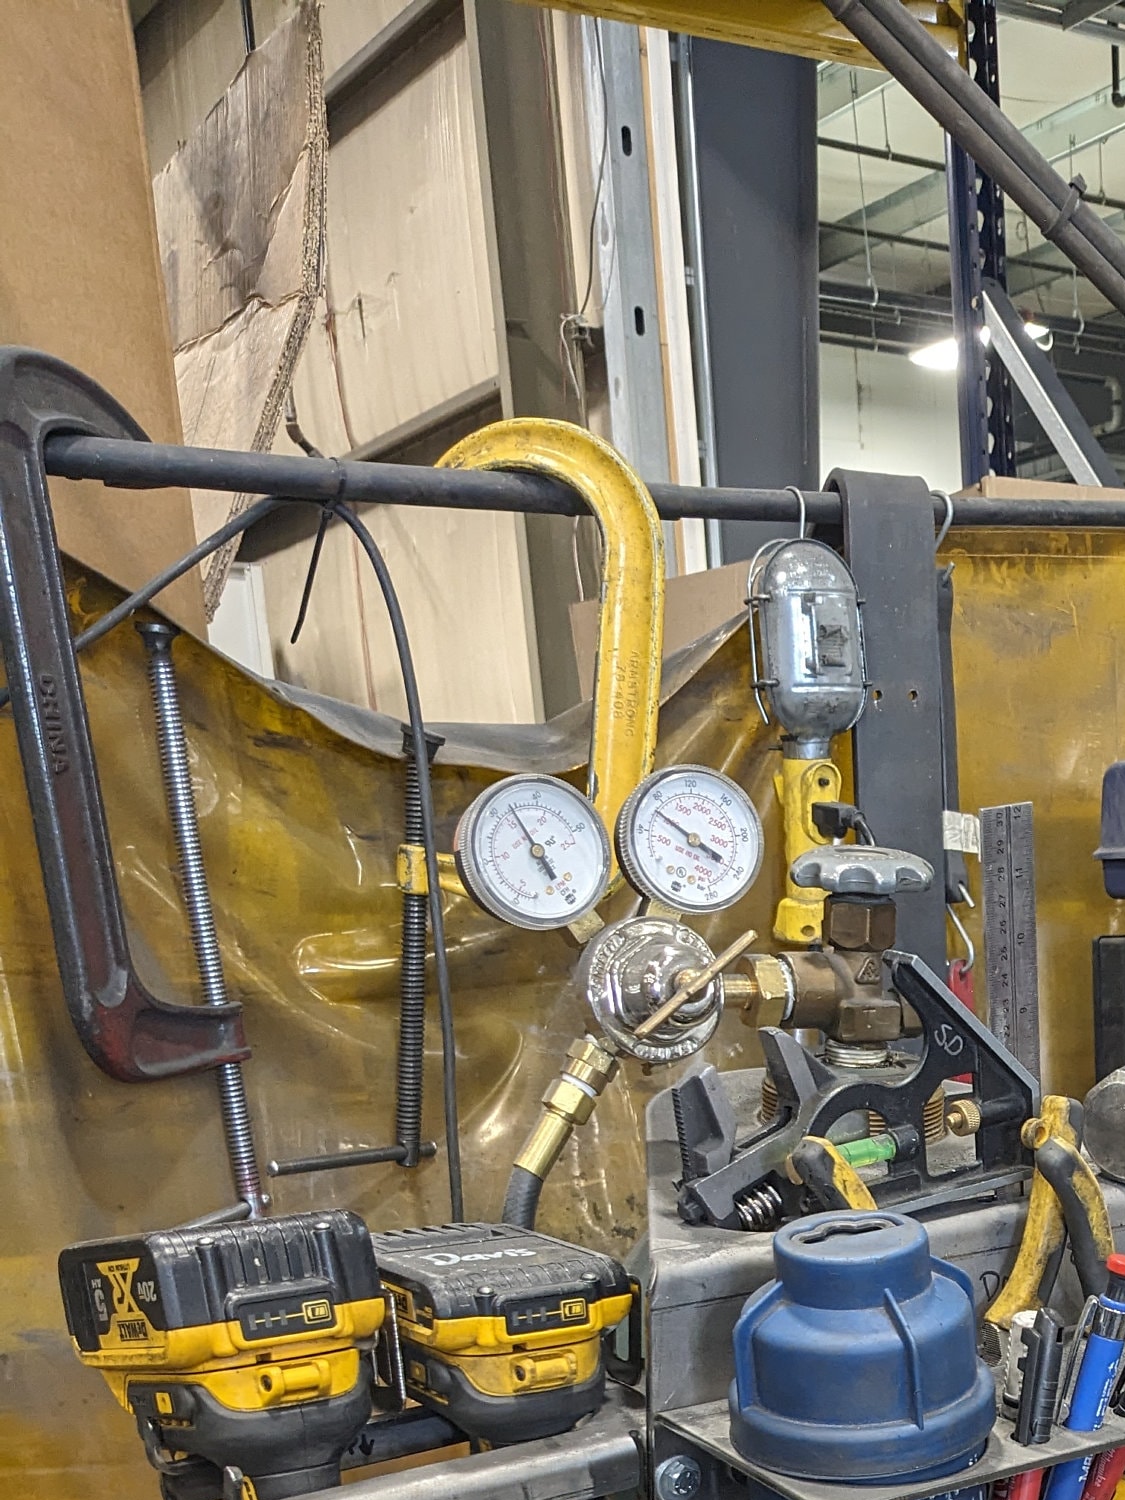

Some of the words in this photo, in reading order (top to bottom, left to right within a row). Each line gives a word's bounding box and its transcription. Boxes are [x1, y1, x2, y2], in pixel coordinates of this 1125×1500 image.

[624, 651, 640, 737] ARMSTRONG
[41, 675, 69, 775] CHINA
[692, 802, 711, 816] 2000
[1014, 806, 1021, 820] 12
[708, 817, 726, 831] 2500
[709, 834, 729, 849] 3000
[996, 839, 1005, 854] 29
[1015, 866, 1023, 879] 11
[999, 894, 1006, 908] 27
[1018, 932, 1025, 945] 10
[934, 1024, 964, 1056] SD
[418, 1248, 537, 1266] Davis
[94, 1289, 109, 1321] 5
